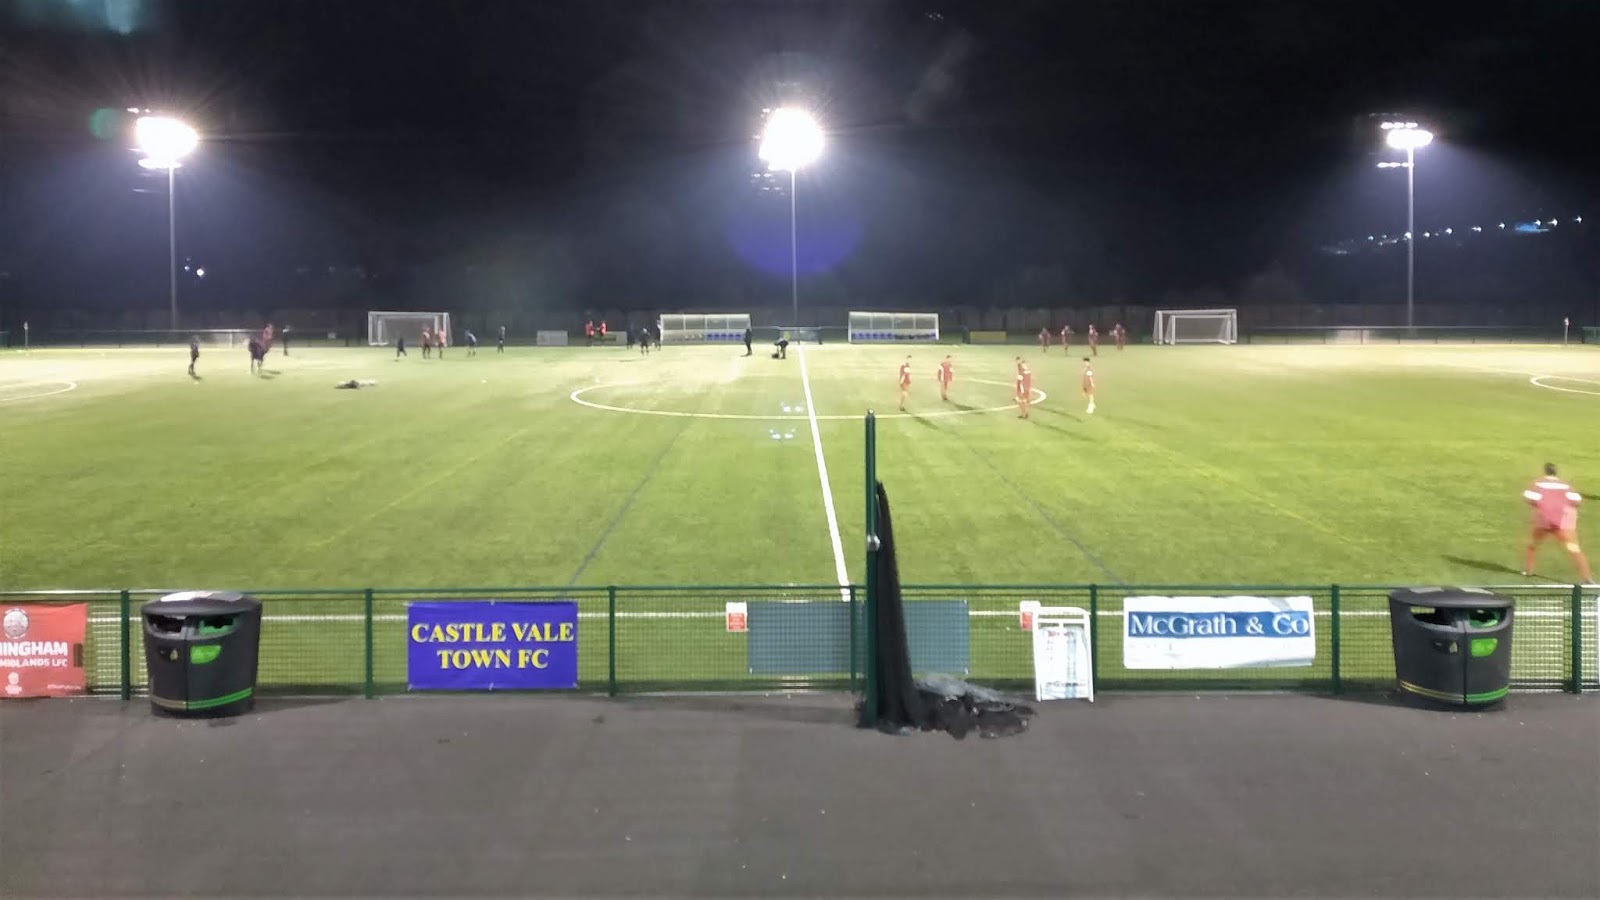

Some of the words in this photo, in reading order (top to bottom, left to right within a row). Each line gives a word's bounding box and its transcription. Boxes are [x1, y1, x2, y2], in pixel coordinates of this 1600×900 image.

[411, 623, 507, 643] CASTLE
[511, 623, 575, 642] VALE
[1131, 614, 1237, 635] McGrath
[1246, 616, 1265, 635] &
[1272, 613, 1310, 635] Co
[0, 641, 68, 657] INGHAM
[437, 649, 511, 669] TOWN
[518, 649, 549, 669] FC
